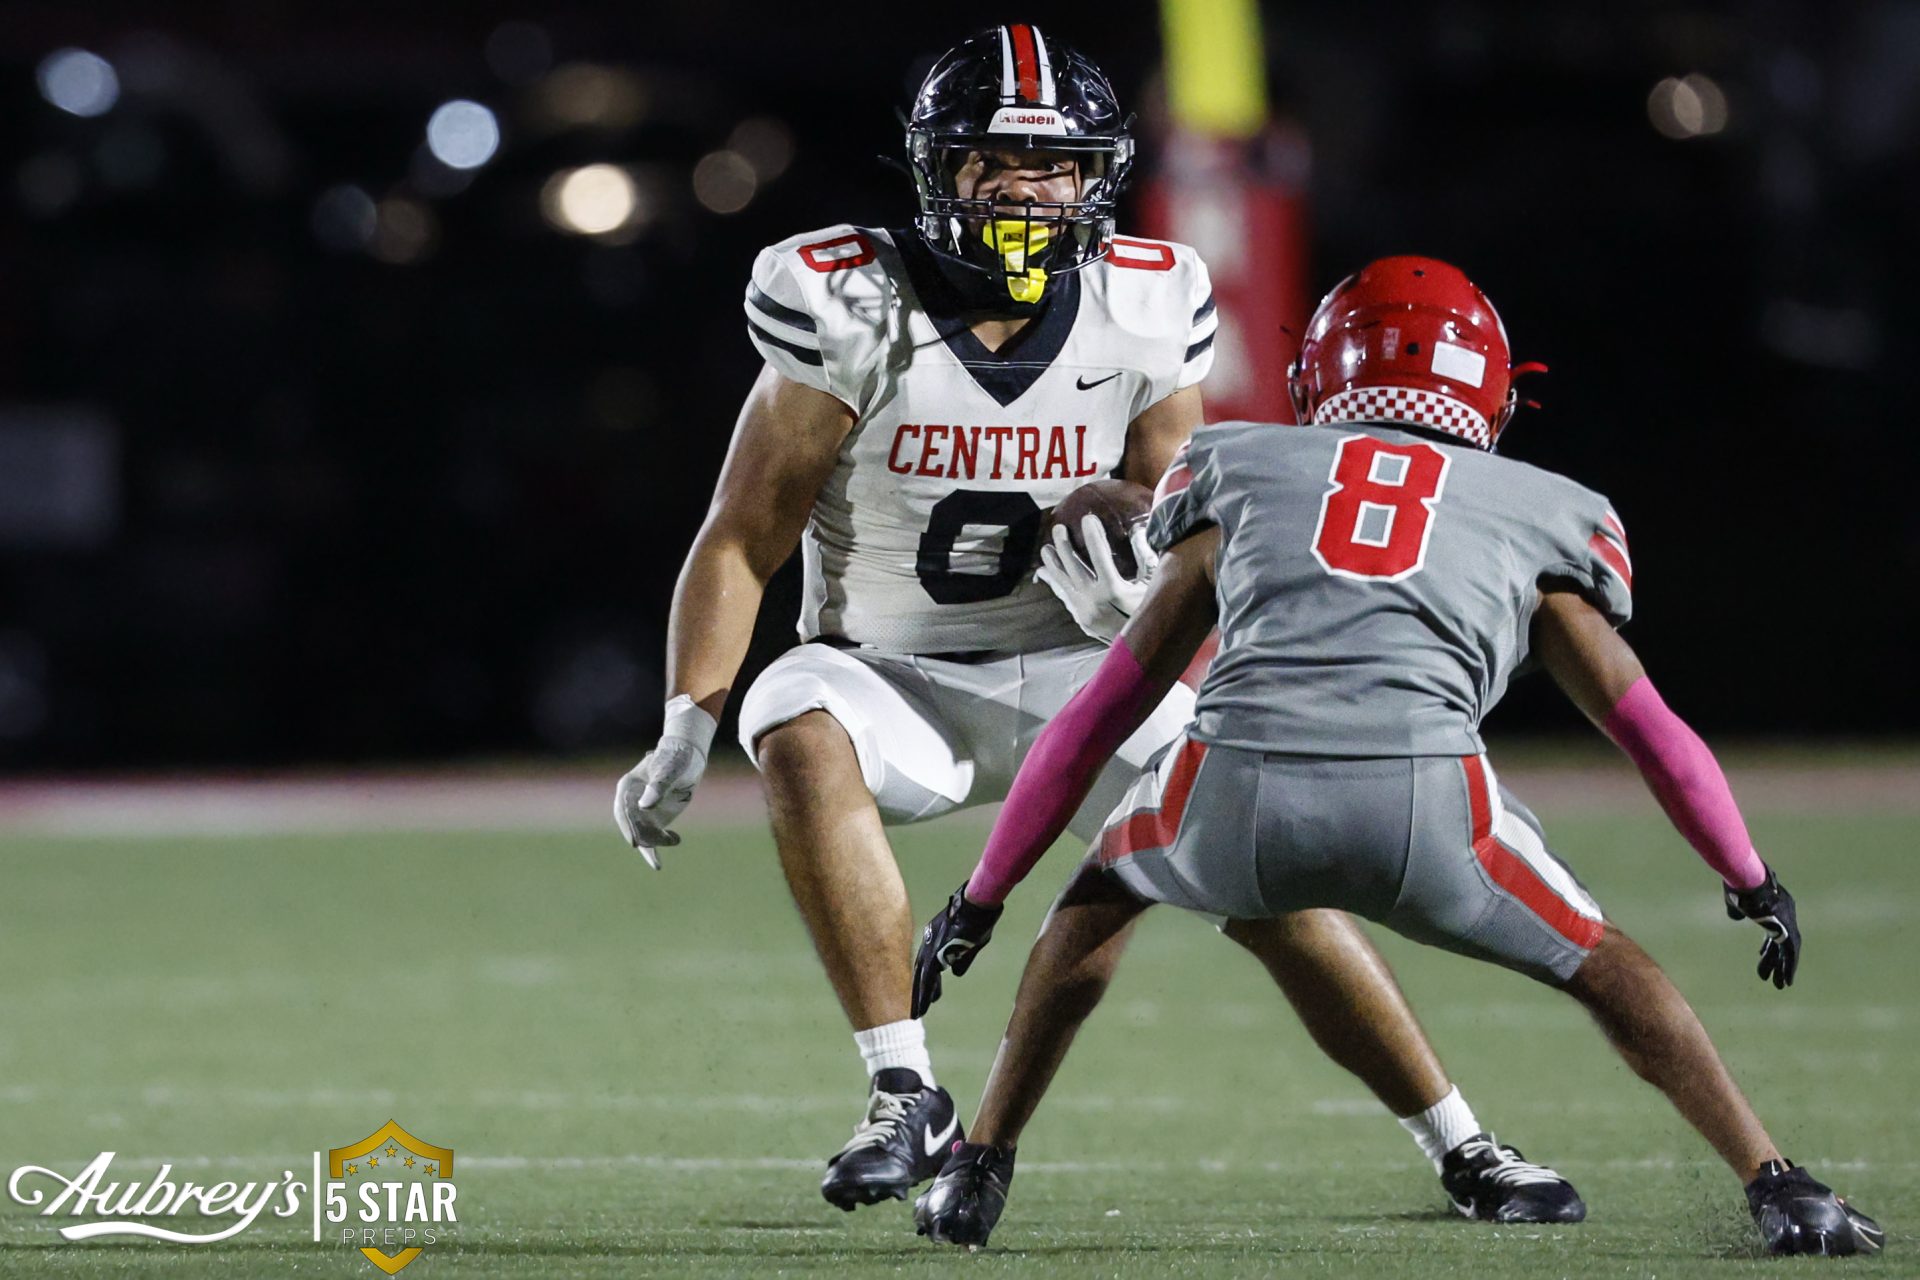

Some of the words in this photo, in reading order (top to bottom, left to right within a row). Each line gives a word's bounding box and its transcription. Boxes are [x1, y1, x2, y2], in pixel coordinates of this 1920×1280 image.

[999, 112, 1056, 125] Rddell
[797, 233, 877, 273] 0
[1101, 239, 1176, 272] 0
[888, 424, 1097, 480] CENTRAL
[1310, 434, 1452, 583] 8
[916, 488, 1042, 605] 0
